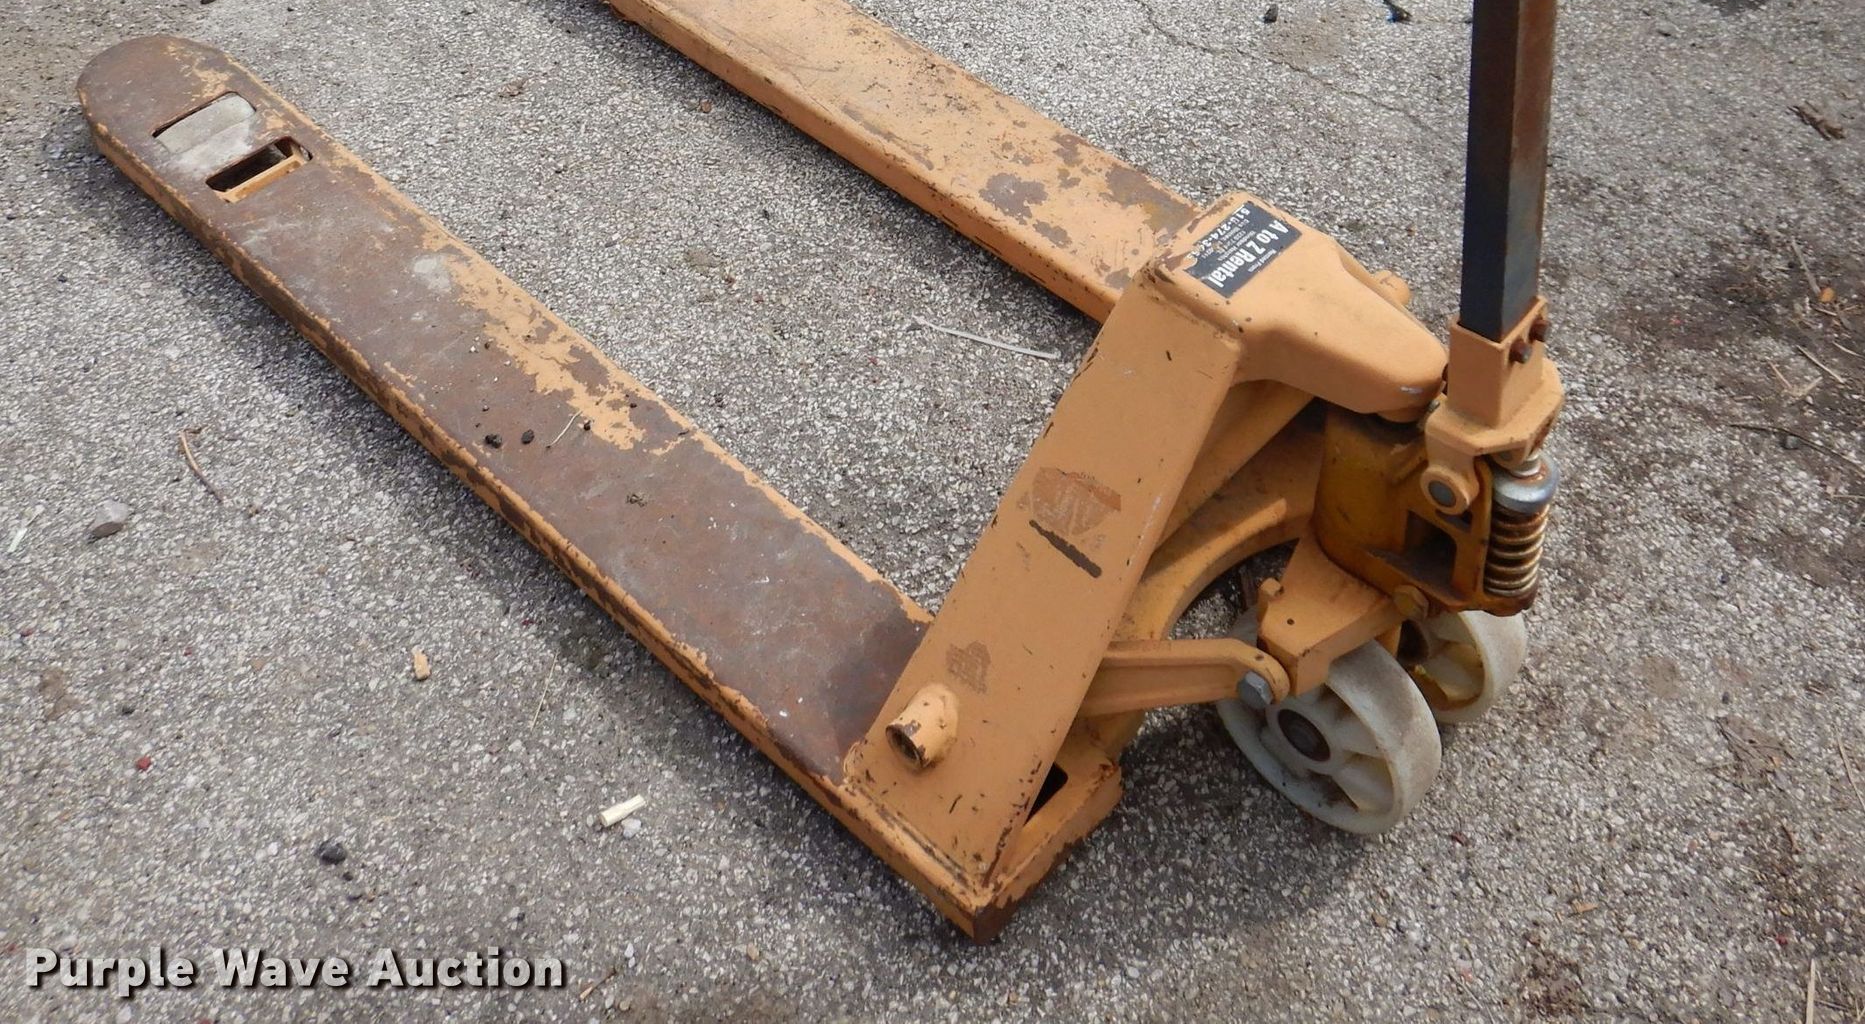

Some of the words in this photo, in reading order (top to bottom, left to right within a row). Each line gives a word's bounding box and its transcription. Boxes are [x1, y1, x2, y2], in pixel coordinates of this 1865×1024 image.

[1268, 220, 1289, 234] A
[1256, 229, 1279, 244] to
[1246, 240, 1266, 254] Z
[1207, 248, 1257, 288] Rental
